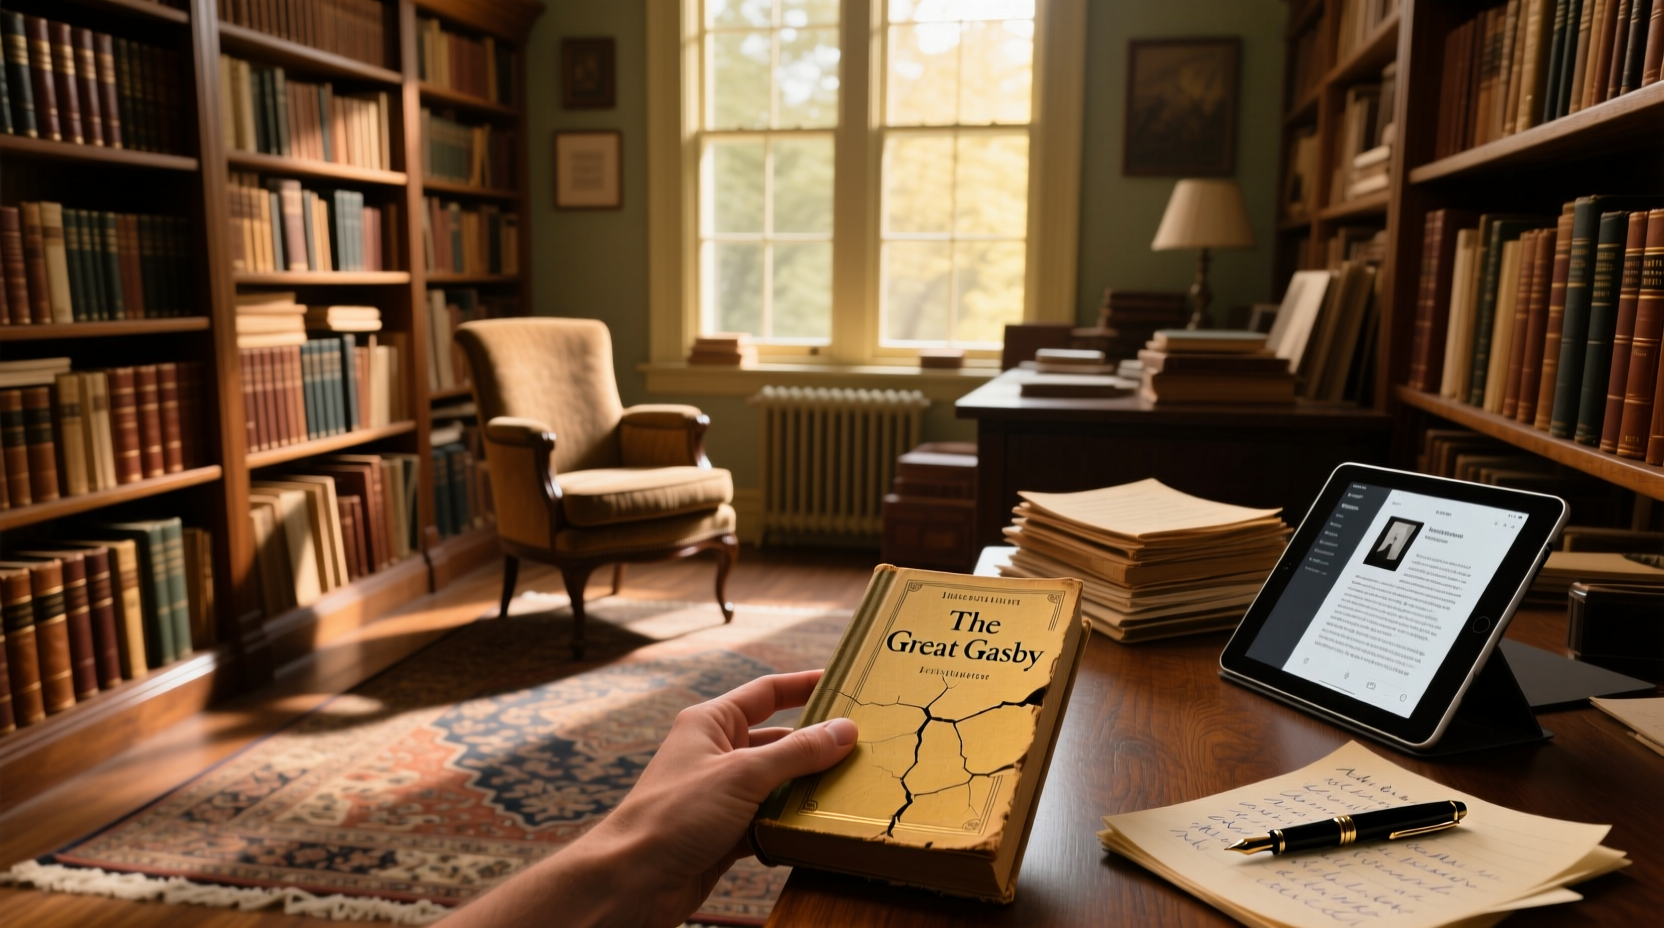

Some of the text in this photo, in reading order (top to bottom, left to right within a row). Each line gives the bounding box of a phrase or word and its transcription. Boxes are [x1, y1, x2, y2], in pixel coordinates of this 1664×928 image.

[949, 610, 1001, 634] The
[886, 630, 1045, 672] Great Gasby
